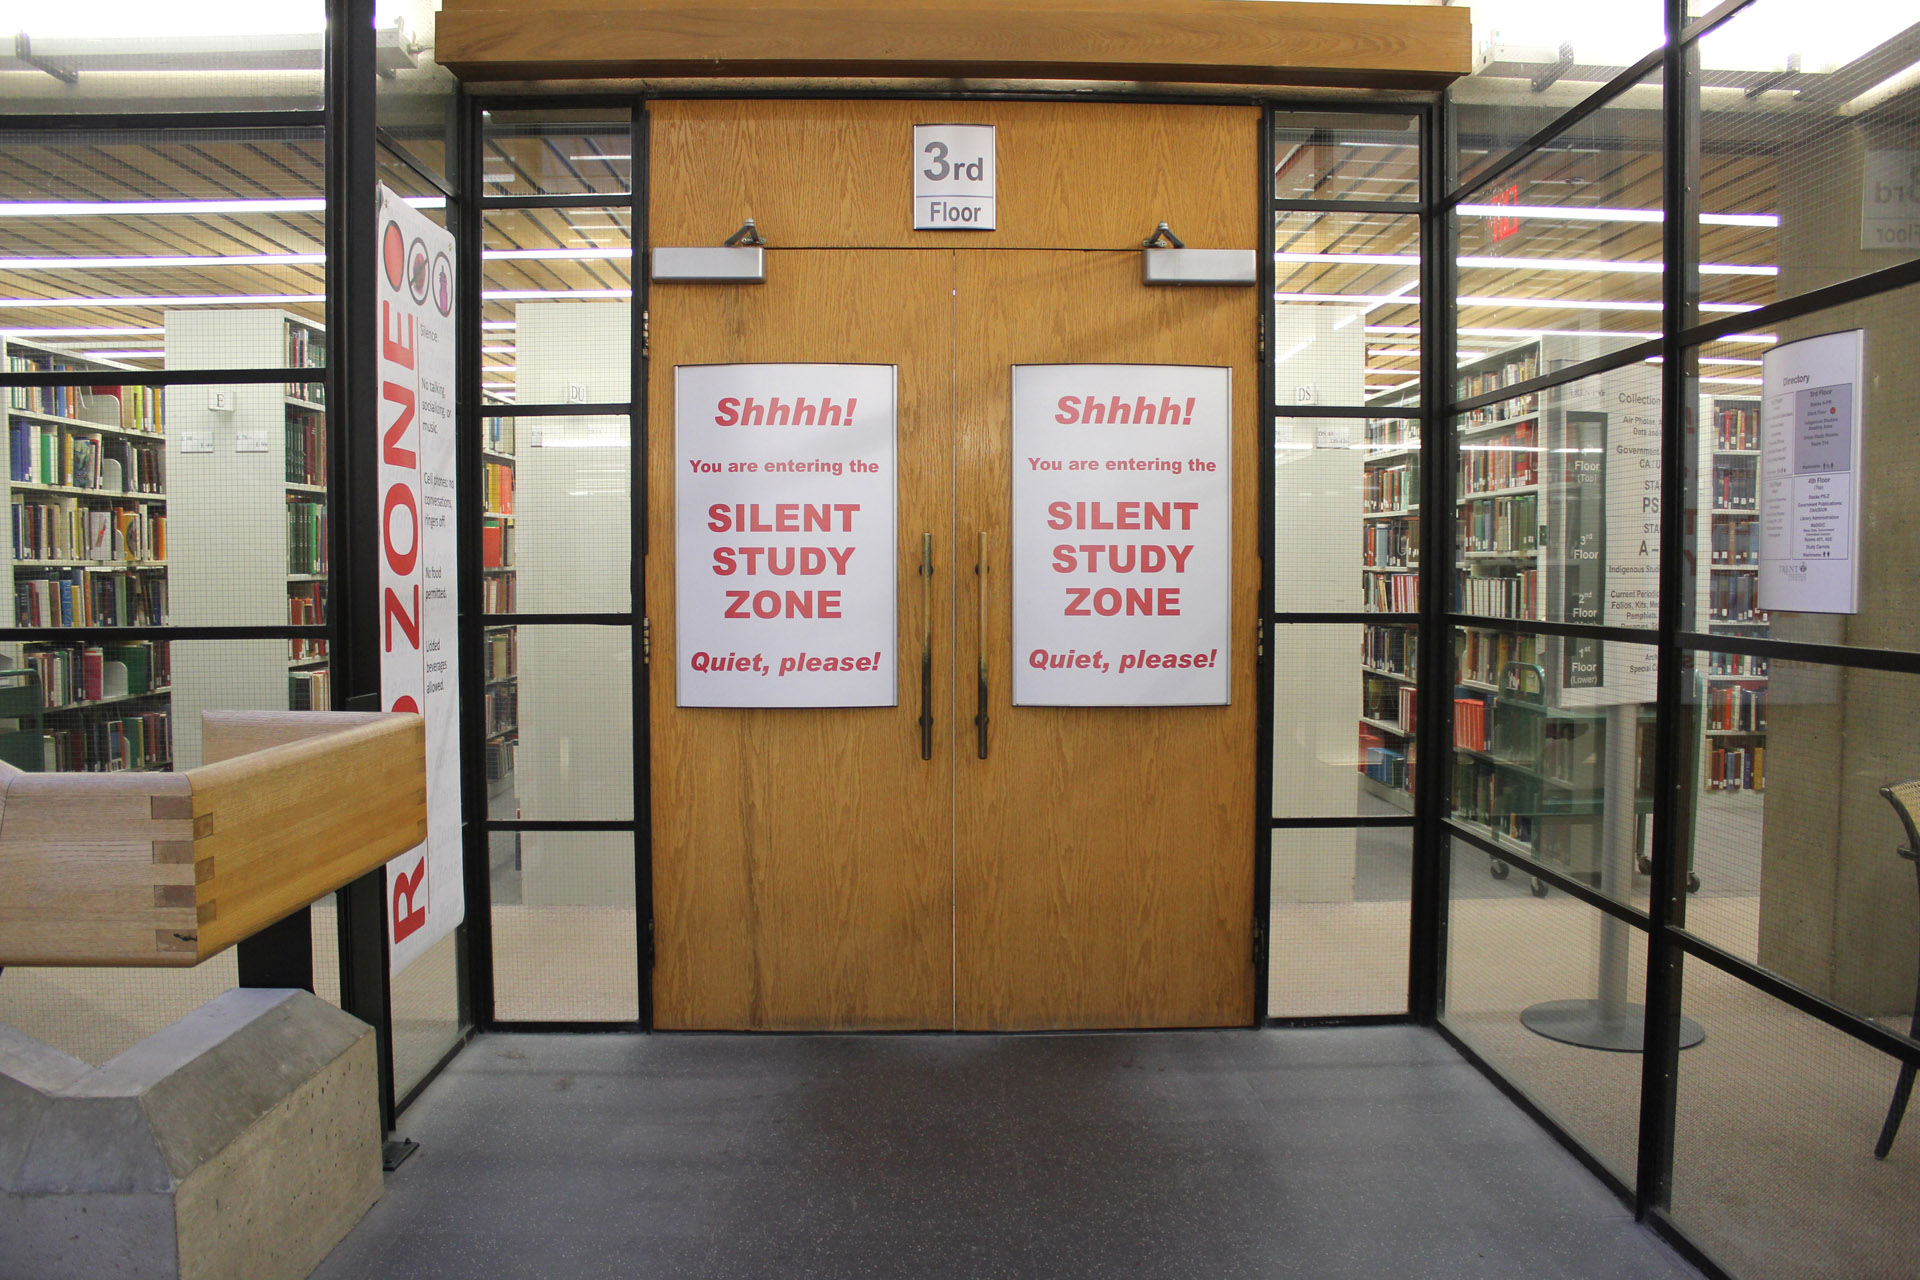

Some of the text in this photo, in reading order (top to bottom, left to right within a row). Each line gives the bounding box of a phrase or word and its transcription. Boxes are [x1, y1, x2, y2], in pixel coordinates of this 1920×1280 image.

[923, 141, 984, 182] 3rd
[930, 201, 982, 222] Floor
[1782, 373, 1810, 387] Directory
[571, 385, 585, 401] DU
[1297, 387, 1312, 402] DS
[1819, 388, 1833, 396] Floor
[216, 393, 225, 408] E
[714, 397, 858, 427] Shhhh!
[1054, 395, 1196, 425] Shhhh!
[689, 459, 879, 476] You are entering the
[1028, 457, 1217, 474] You are entering the
[1574, 460, 1601, 471] Floor
[383, 299, 420, 653] ZONE
[1642, 497, 1660, 513] PS
[707, 503, 861, 533] SILENT
[1047, 501, 1199, 531] SILENT
[1580, 533, 1593, 546] 3rd
[1573, 549, 1599, 560] Floor
[1639, 540, 1649, 556] A
[712, 547, 856, 576] STUDY
[1052, 544, 1195, 574] STUDY
[1608, 565, 1645, 575] Indigenous
[1064, 587, 1181, 617] ZONE
[1578, 591, 1593, 604] 2nd
[1610, 590, 1636, 599] Current
[724, 590, 842, 619] ZONE
[1572, 608, 1597, 618] Floor
[1578, 646, 1591, 658] 1st
[426, 659, 448, 674] beverages
[690, 652, 881, 676] Quiet, please!
[1029, 648, 1218, 674] Quiet, please!
[1571, 662, 1598, 673] Floor
[1570, 676, 1598, 686] (Lower)
